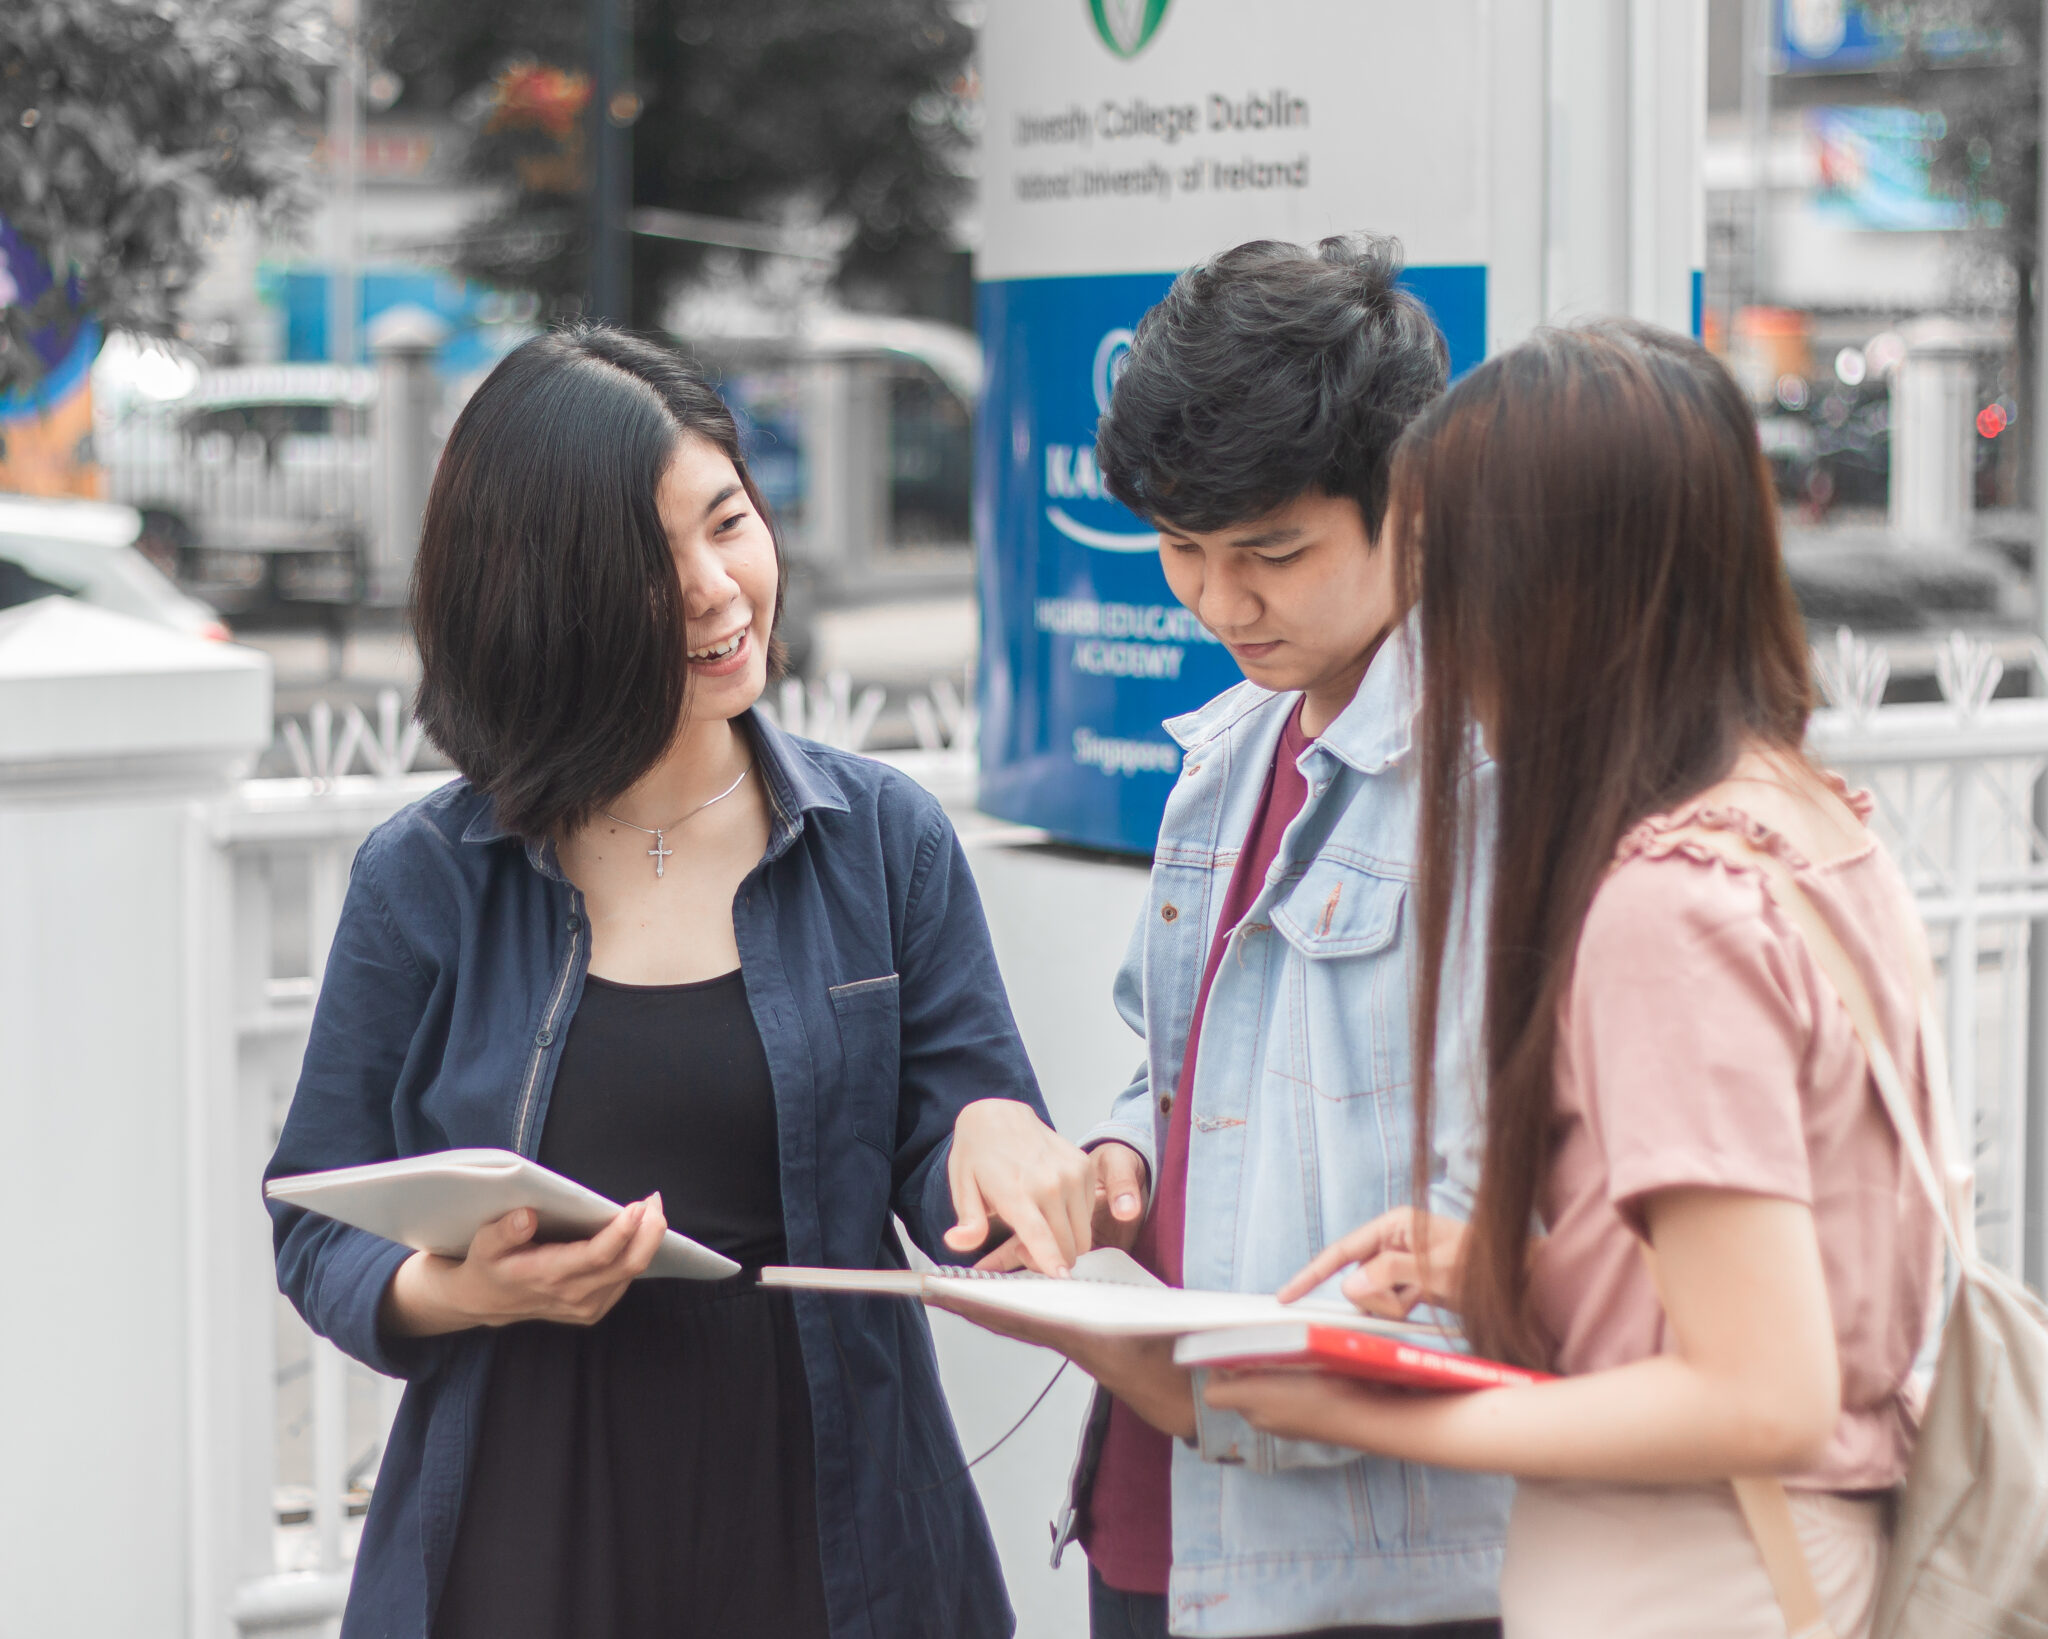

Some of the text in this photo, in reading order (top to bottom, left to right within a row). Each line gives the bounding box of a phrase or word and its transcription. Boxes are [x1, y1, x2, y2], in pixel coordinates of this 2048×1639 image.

[1097, 99, 1200, 142] College
[1207, 90, 1309, 132] Dublin
[1178, 158, 1201, 190] of
[1211, 154, 1309, 190] Ireland
[1072, 640, 1184, 679] ACADEMY
[1072, 727, 1180, 778] Singapore
